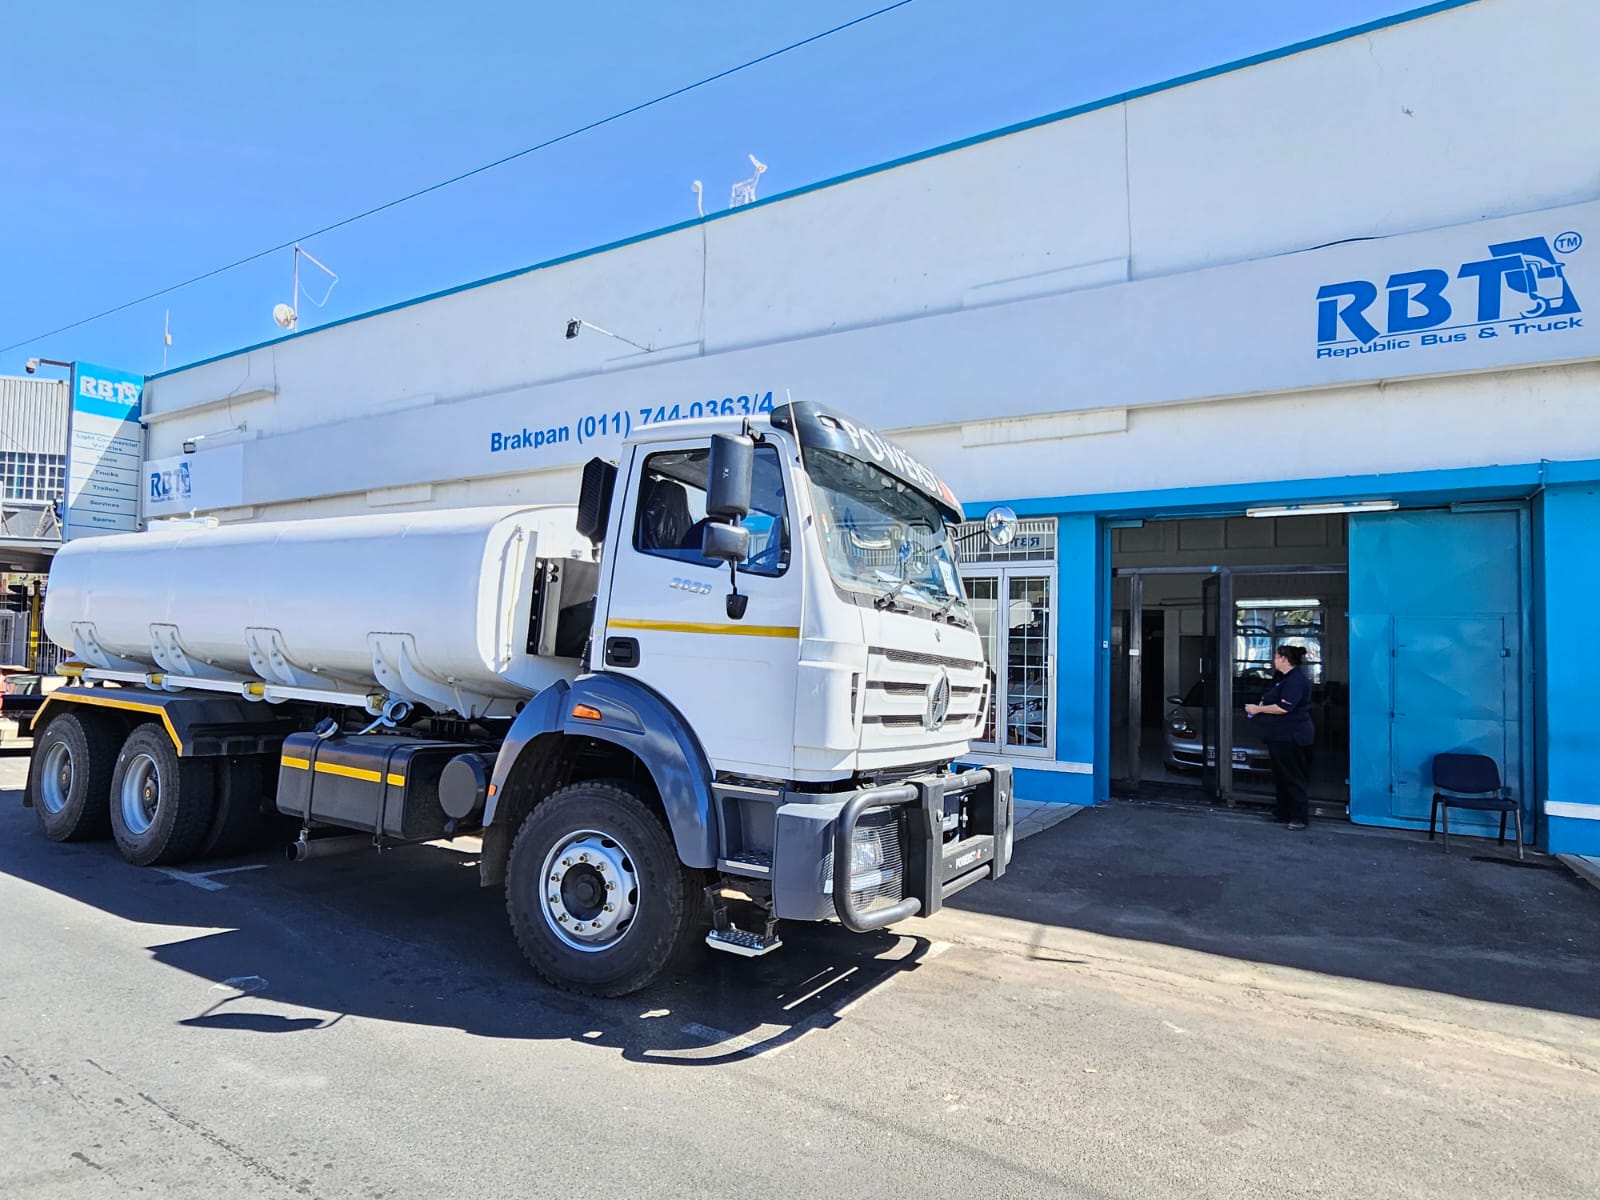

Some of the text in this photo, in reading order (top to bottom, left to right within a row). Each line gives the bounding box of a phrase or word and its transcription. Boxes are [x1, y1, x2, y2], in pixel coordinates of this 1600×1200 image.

[1558, 236, 1578, 249] TM
[1316, 253, 1526, 345] RBT
[1316, 317, 1584, 359] Republic Bus & Truck
[490, 391, 774, 453] Brakpan (011) 744-0363/4
[95, 469, 119, 478] Trucks
[92, 484, 120, 493] Trailers
[90, 499, 120, 508] Services
[92, 516, 116, 524] Spares
